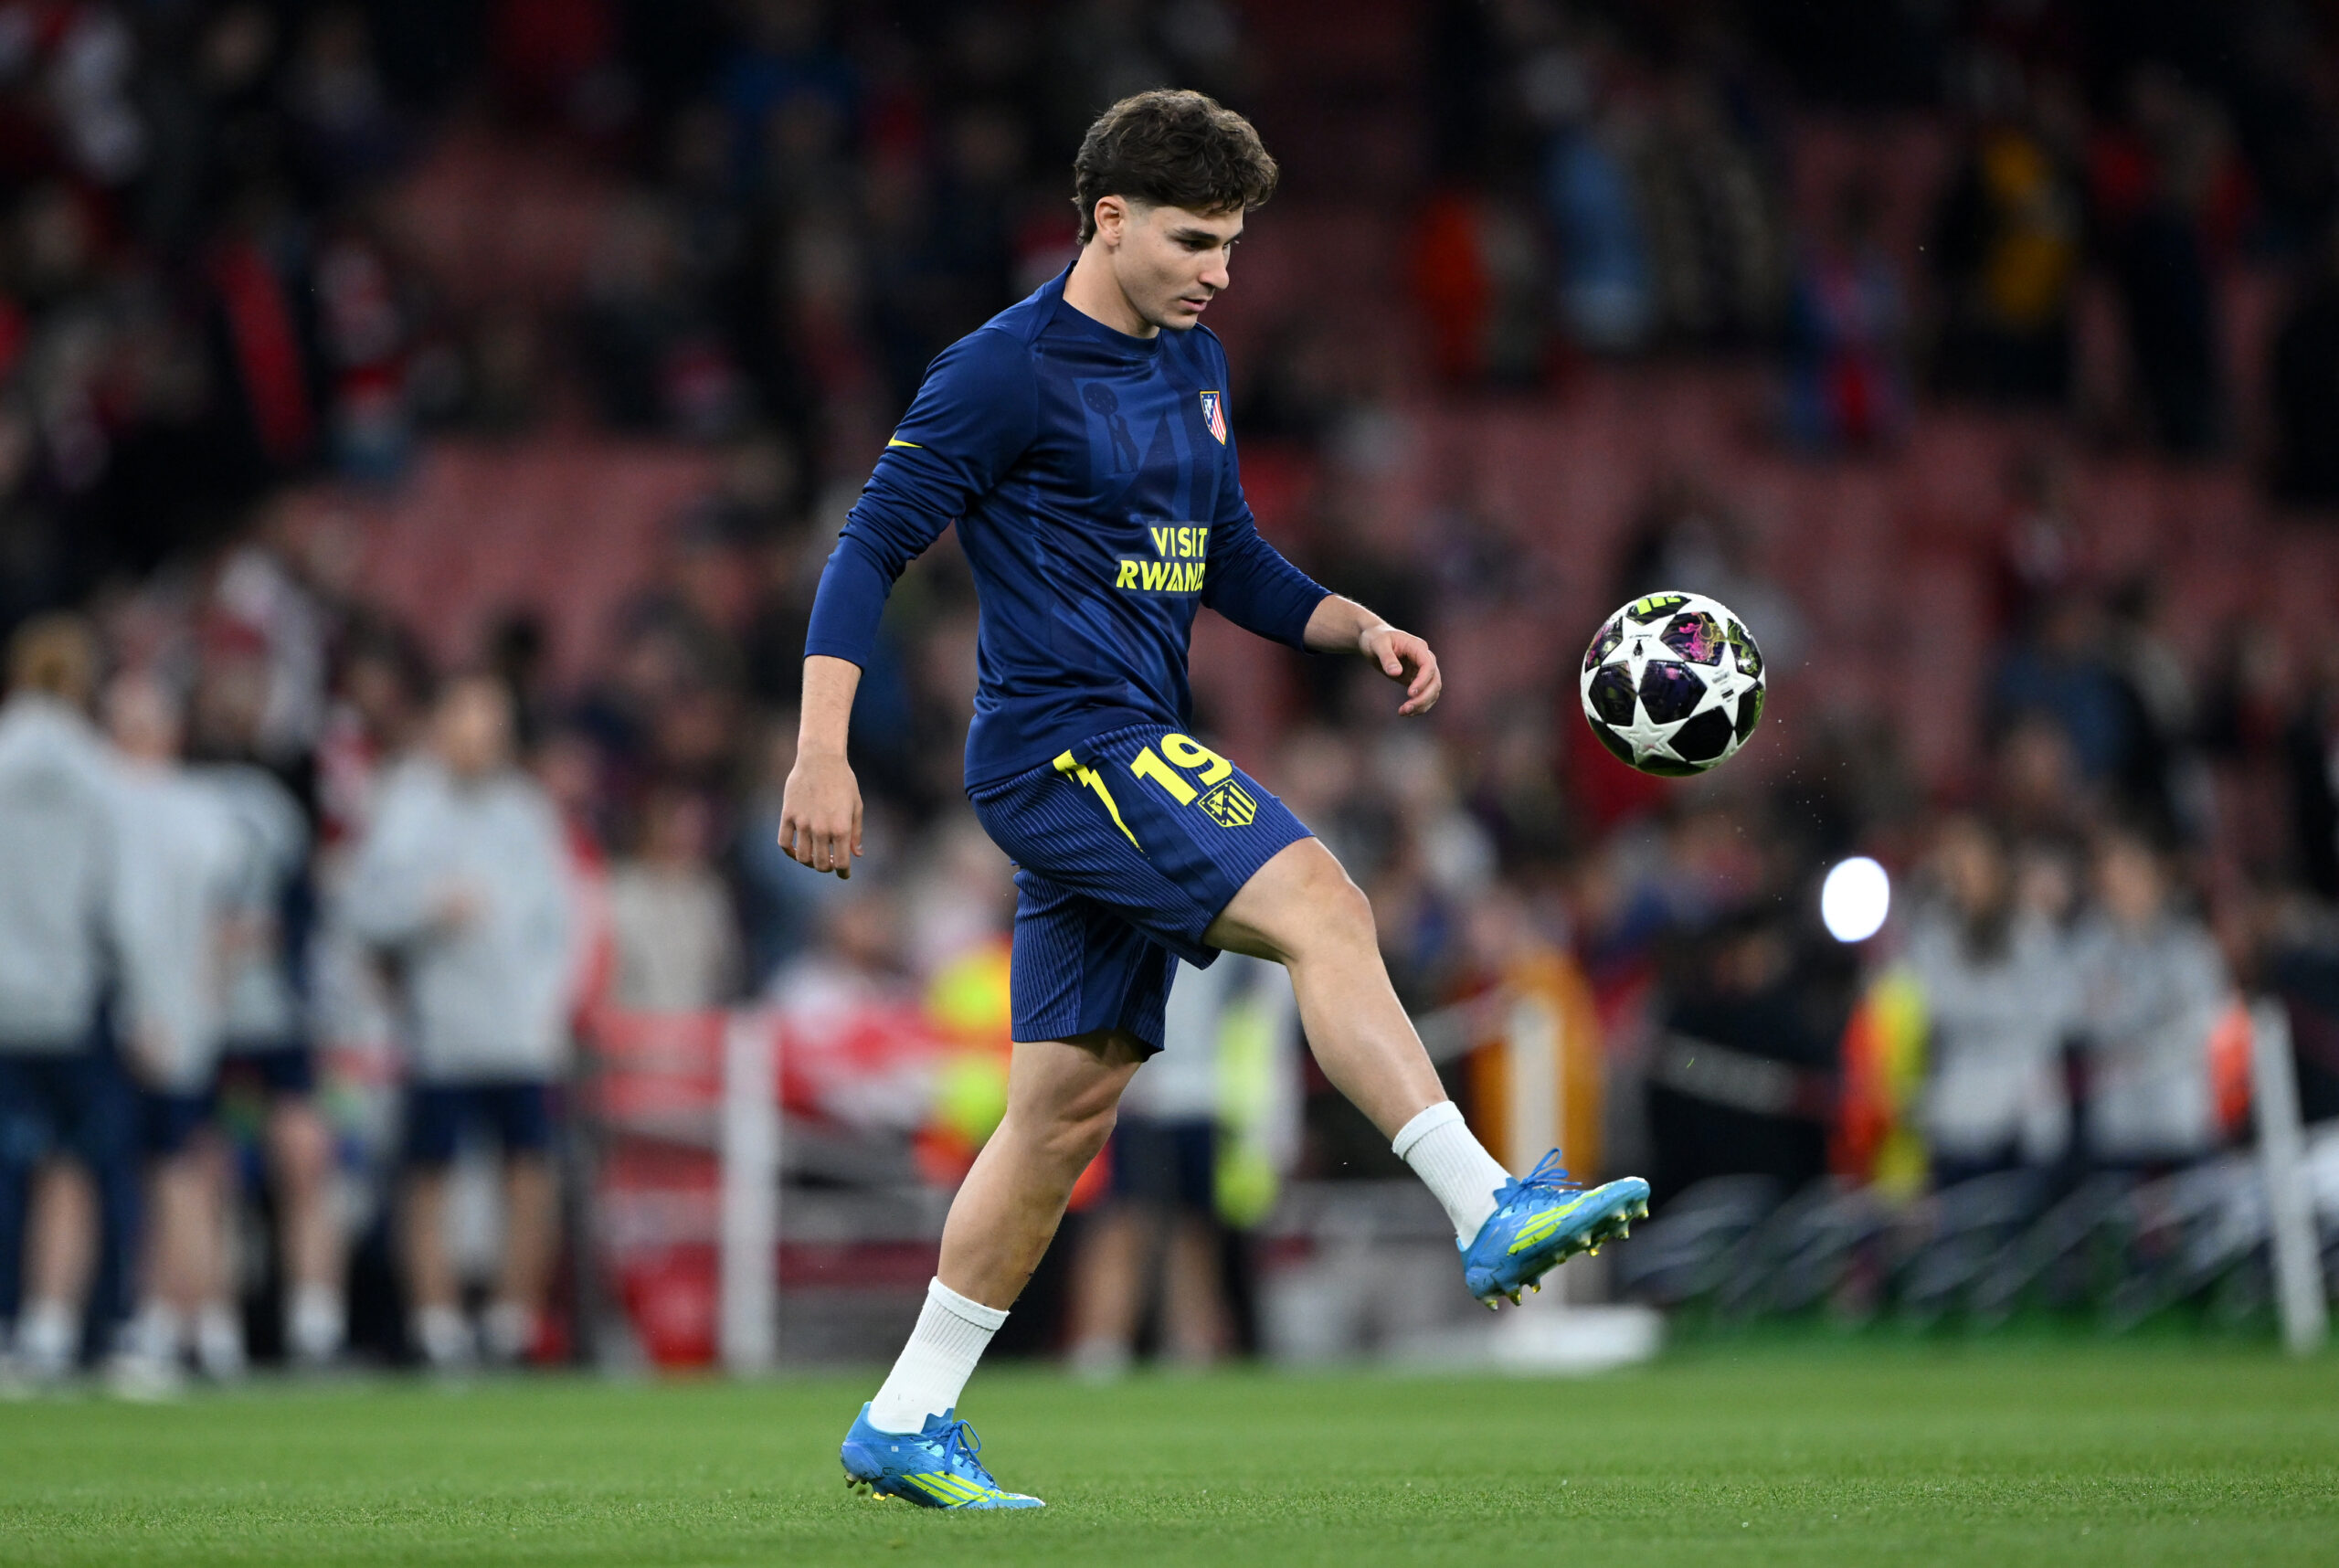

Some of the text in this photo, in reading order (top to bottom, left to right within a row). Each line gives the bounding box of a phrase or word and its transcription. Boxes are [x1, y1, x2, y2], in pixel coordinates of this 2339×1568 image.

[1150, 526, 1208, 558] VISIT
[1116, 559, 1206, 592] RWAND
[1129, 733, 1233, 806] 19
